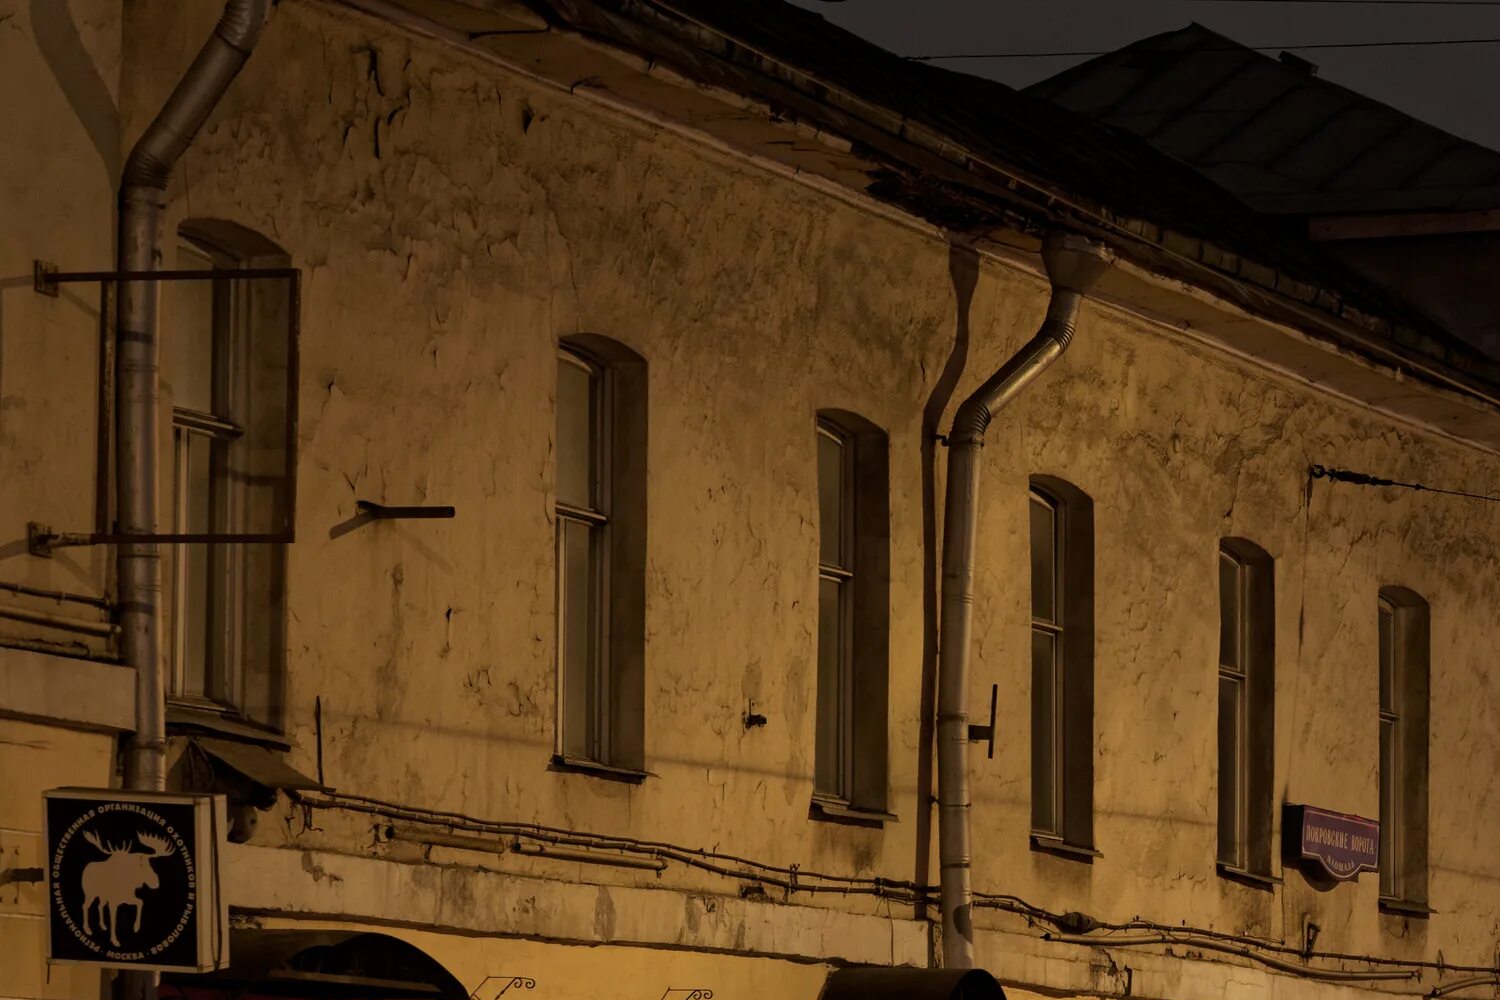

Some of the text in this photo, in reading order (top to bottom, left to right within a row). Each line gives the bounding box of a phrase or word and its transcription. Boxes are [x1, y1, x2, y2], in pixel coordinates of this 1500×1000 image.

[97, 802, 168, 827] ОРГАНИЗАЦИЯ
[52, 808, 96, 879] ОБЩЕСТВЕННАЯ
[166, 825, 196, 889] ОХОТНИКОВ
[1305, 825, 1375, 855] ПОКРОВСКИЕ ВОРОТА
[150, 902, 195, 955] РЫБОЛОВОВ
[105, 949, 146, 961] МОСКВА
